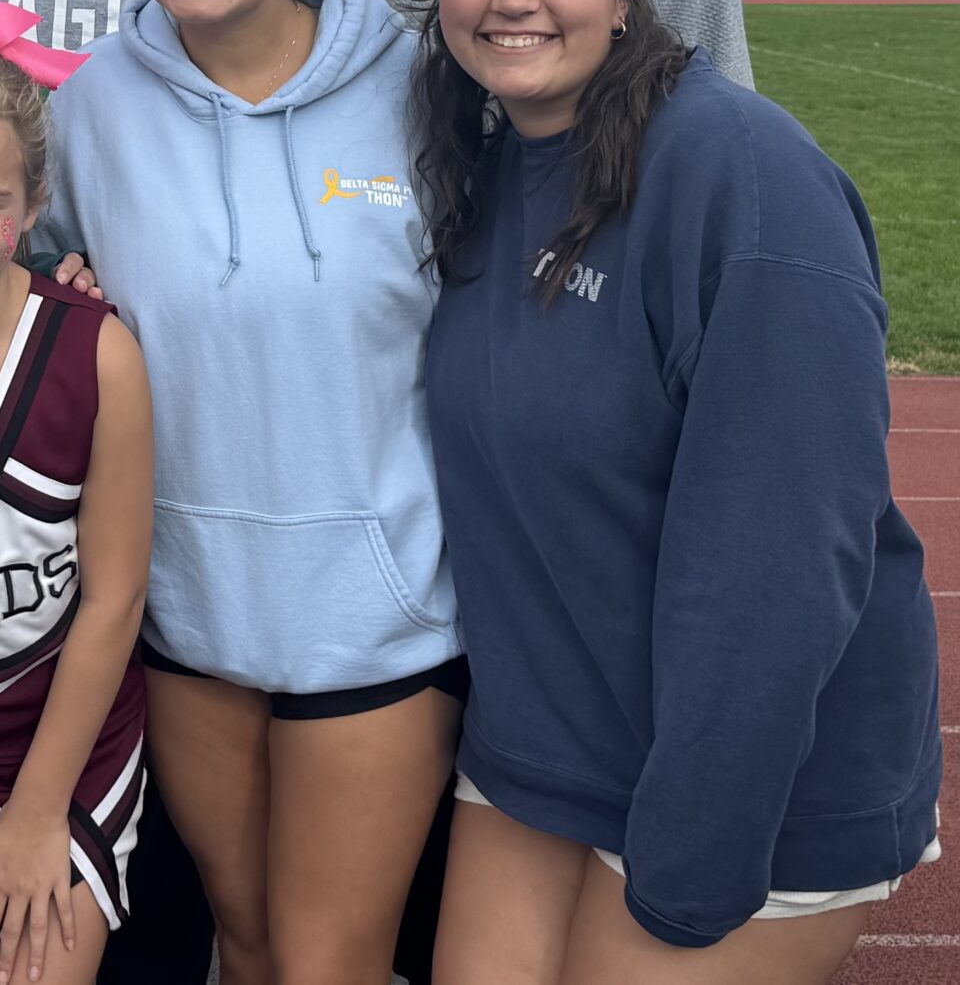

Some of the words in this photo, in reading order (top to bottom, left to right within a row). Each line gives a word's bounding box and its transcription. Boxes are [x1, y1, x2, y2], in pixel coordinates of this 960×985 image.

[340, 179, 369, 189] DELTA
[371, 181, 400, 194] SIGMA
[365, 190, 403, 208] THON
[532, 247, 608, 303] TON
